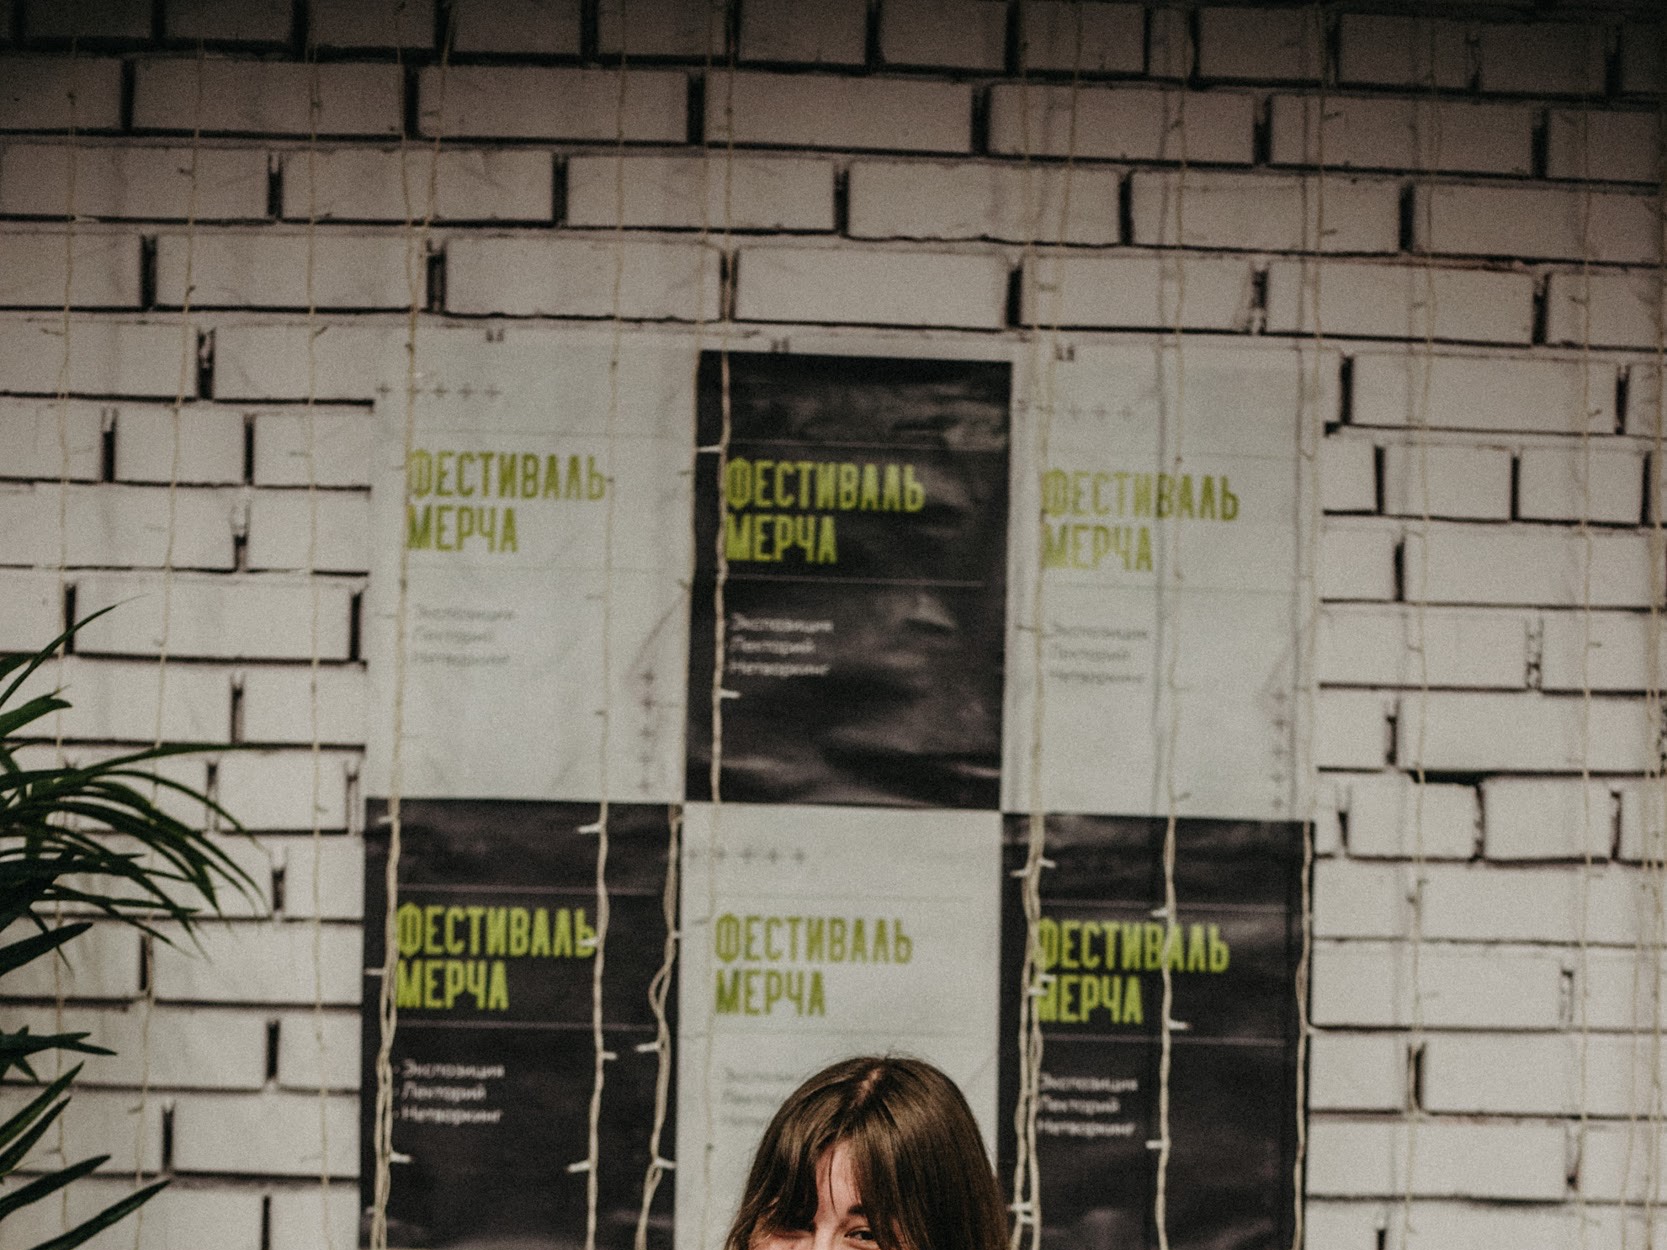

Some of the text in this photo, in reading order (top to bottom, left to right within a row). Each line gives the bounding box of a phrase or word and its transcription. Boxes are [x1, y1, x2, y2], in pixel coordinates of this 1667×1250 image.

[409, 448, 606, 500] ФЕСТИВАЛЬ
[726, 457, 926, 513] ФЕСТИВАЛЬ
[1041, 468, 1239, 521] ФЕСТИВАЛЬ
[406, 503, 518, 553] МЕРЧА
[726, 513, 838, 565] МЕРЧА
[1042, 523, 1153, 572] МЕРЧА
[397, 902, 597, 959] ФЕСТИВАЛЬ
[715, 912, 914, 965] ФЕСТИВАЛЬ
[1036, 917, 1231, 973] ФЕСТИВАЛЬ
[396, 959, 510, 1011] МЕРЧА
[715, 968, 826, 1017] МЕРЧА
[1037, 974, 1144, 1025] МЕРЧА
